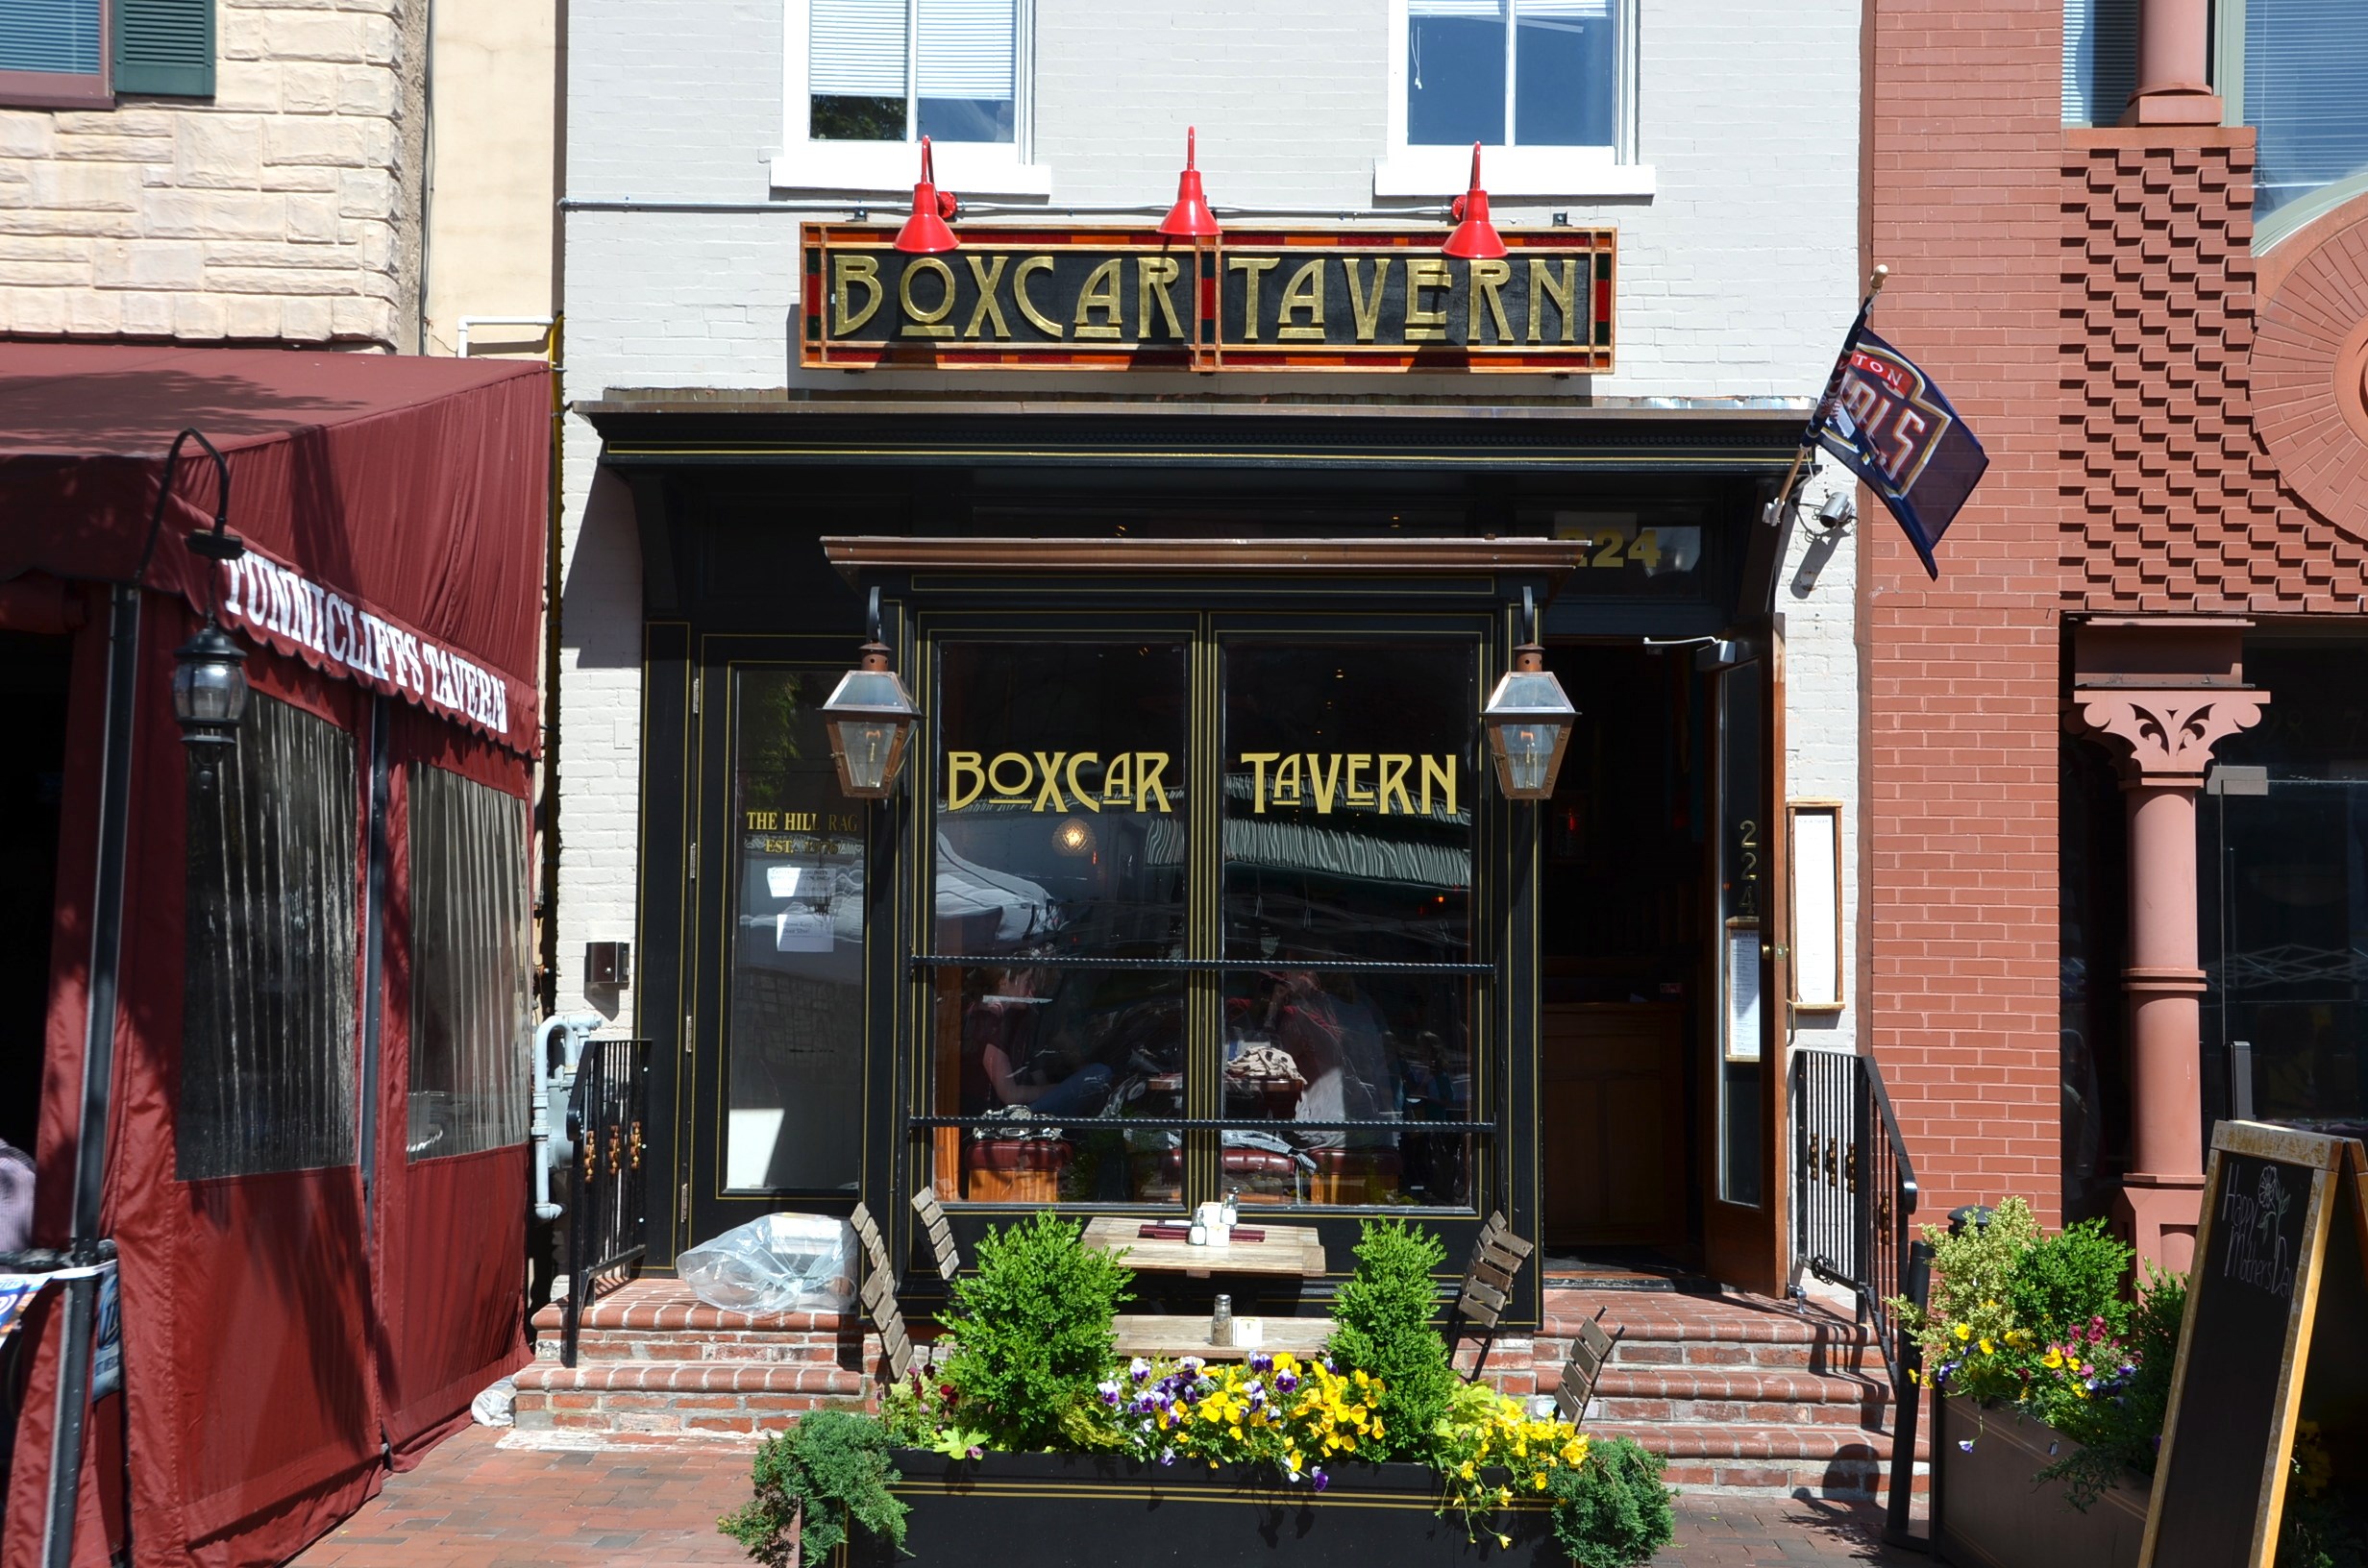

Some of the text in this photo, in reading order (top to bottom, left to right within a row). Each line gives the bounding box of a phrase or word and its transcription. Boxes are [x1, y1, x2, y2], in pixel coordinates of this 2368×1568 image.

[833, 254, 1577, 341] BOXCAR TAVERN
[423, 641, 508, 734] TAVERN
[746, 811, 858, 833] THE HILL RAG
[948, 751, 1458, 816] BOXCAR TAVERN
[2222, 1162, 2258, 1246] Happy
